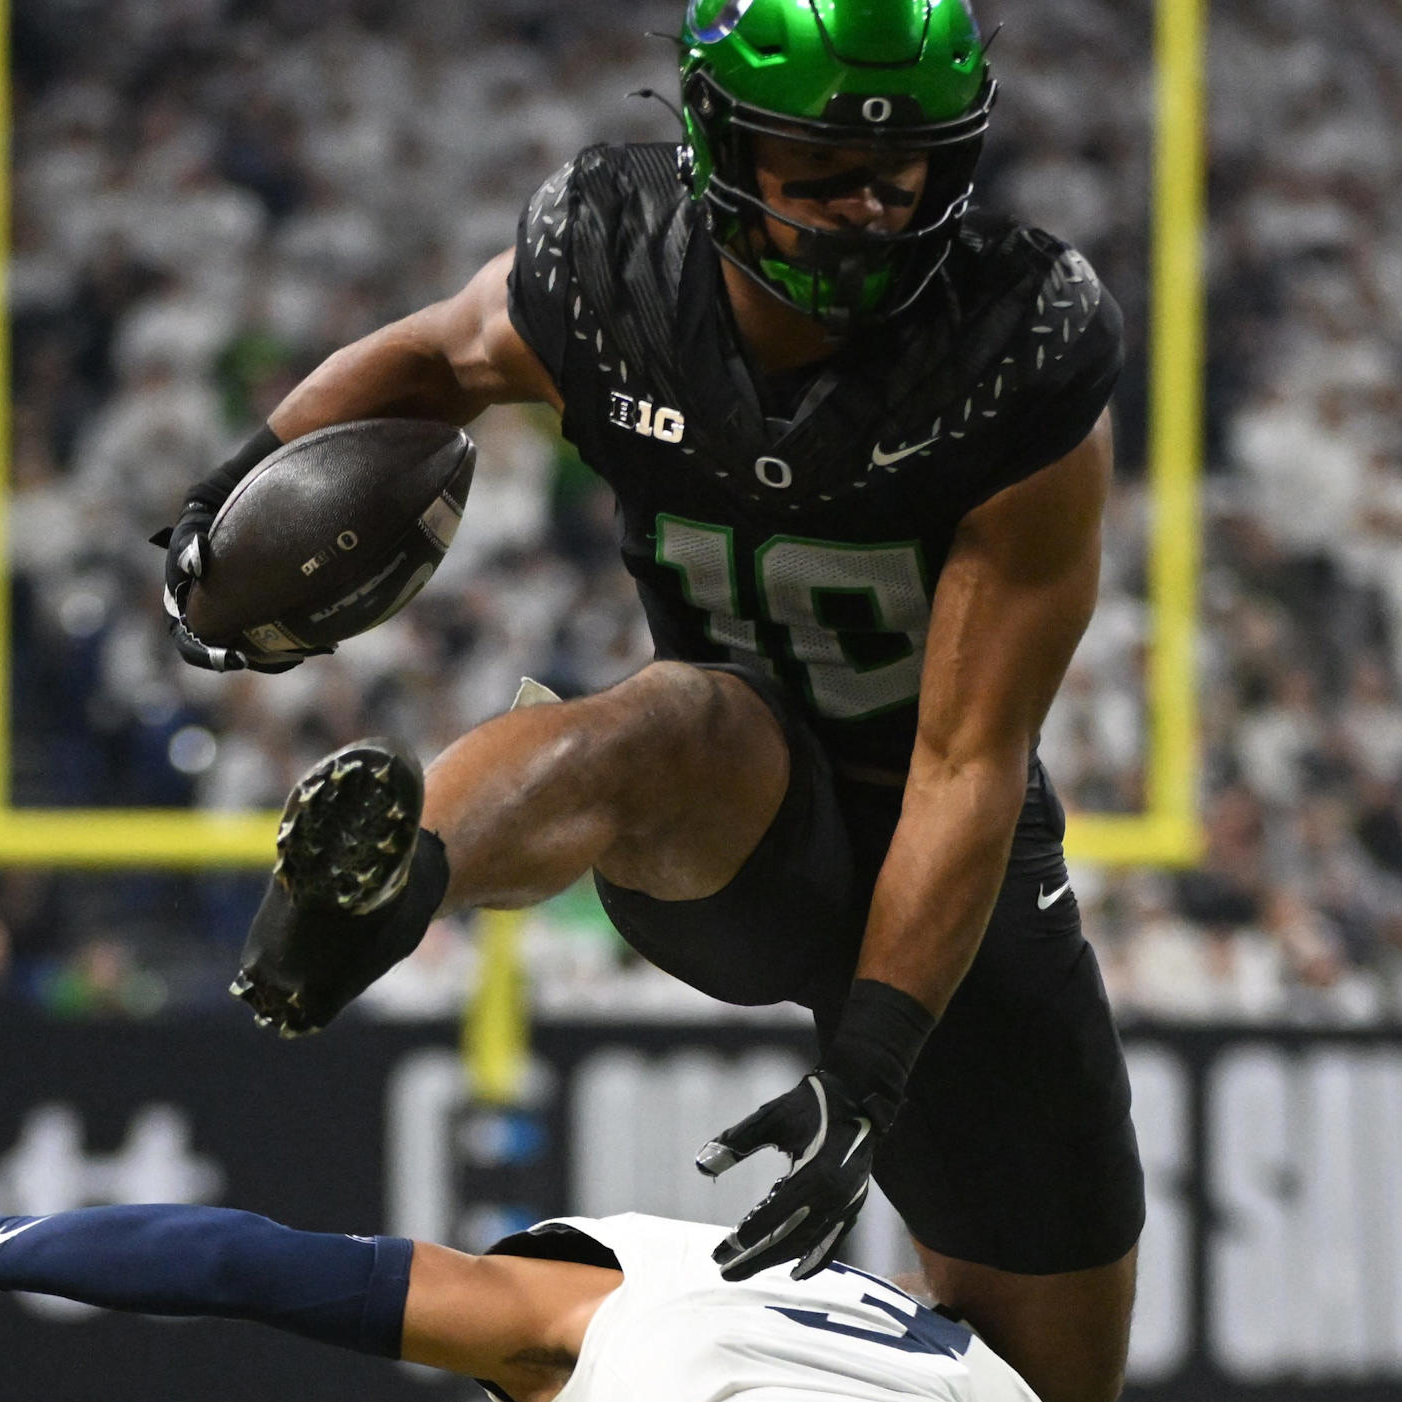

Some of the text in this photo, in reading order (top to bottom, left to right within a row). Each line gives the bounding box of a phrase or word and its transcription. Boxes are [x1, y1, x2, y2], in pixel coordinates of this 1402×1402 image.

[862, 97, 892, 122] O
[755, 456, 792, 489] O
[655, 512, 932, 722] 10
